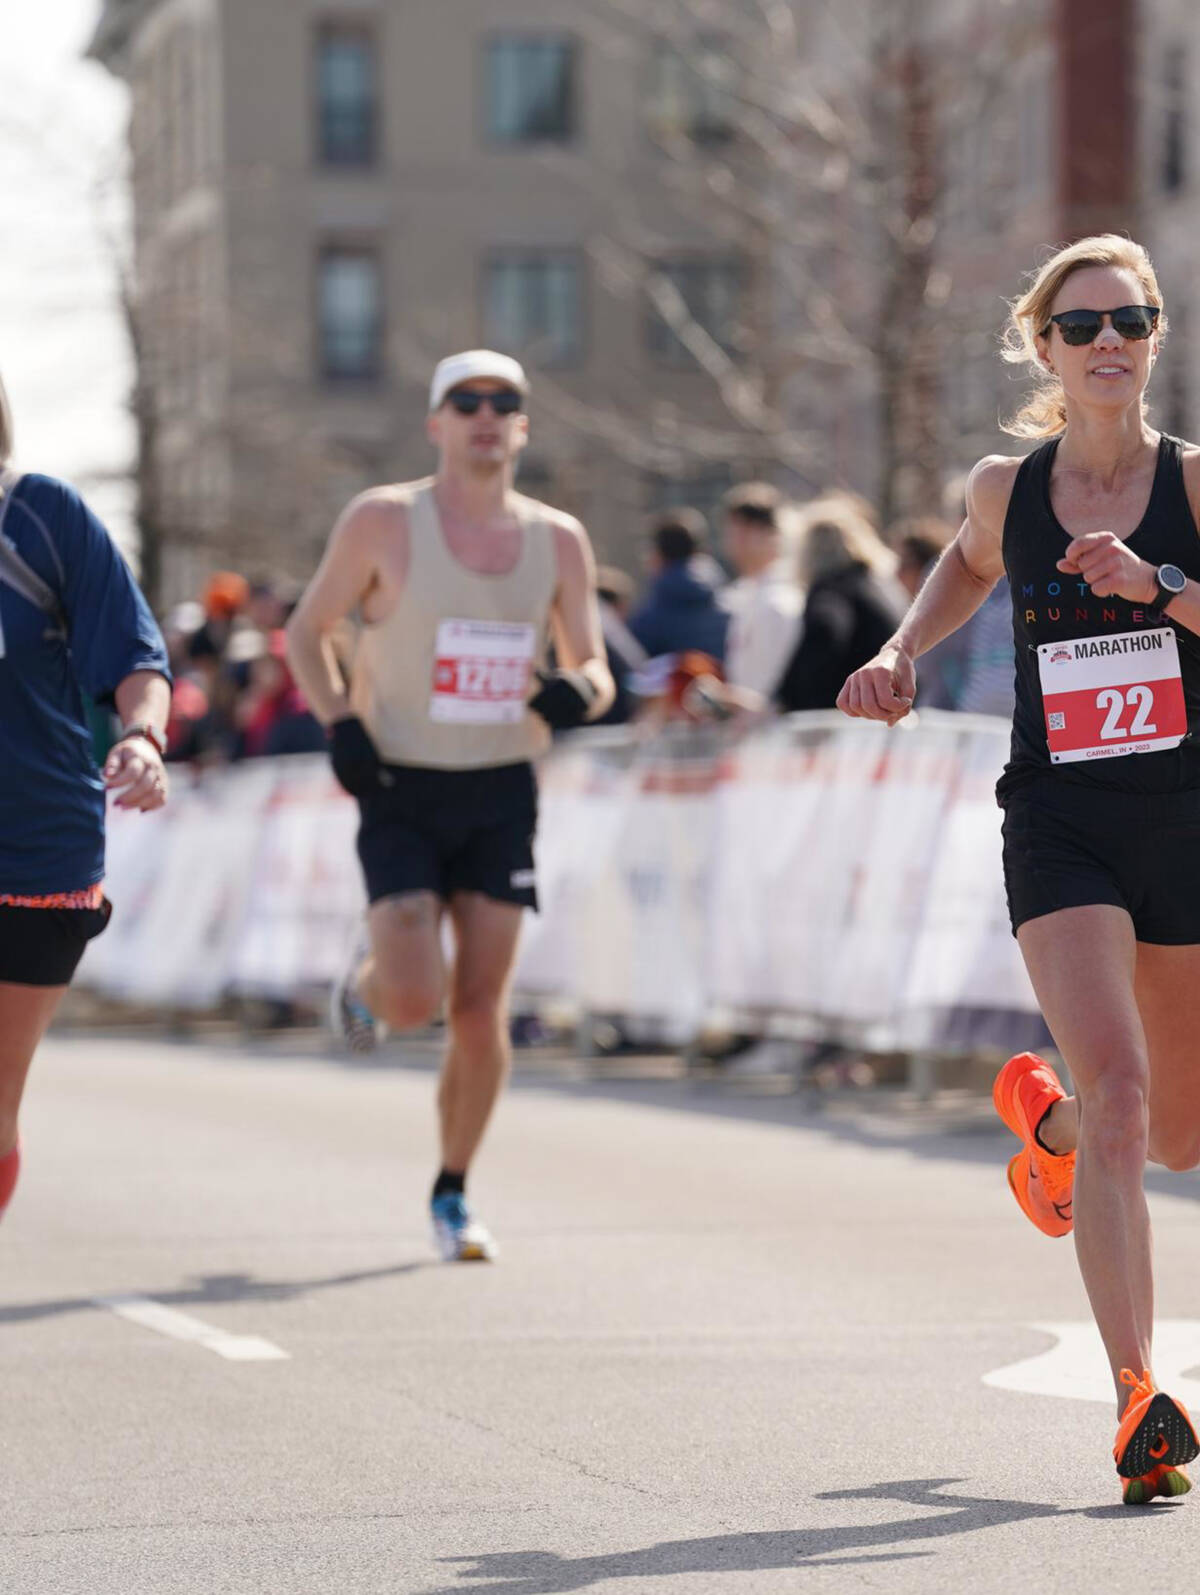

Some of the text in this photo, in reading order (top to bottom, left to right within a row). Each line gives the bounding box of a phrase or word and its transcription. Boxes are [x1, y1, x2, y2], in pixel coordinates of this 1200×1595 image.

[1074, 633, 1163, 659] MARATHON
[1096, 685, 1157, 740] 22
[1086, 748, 1119, 758] CARMEL,
